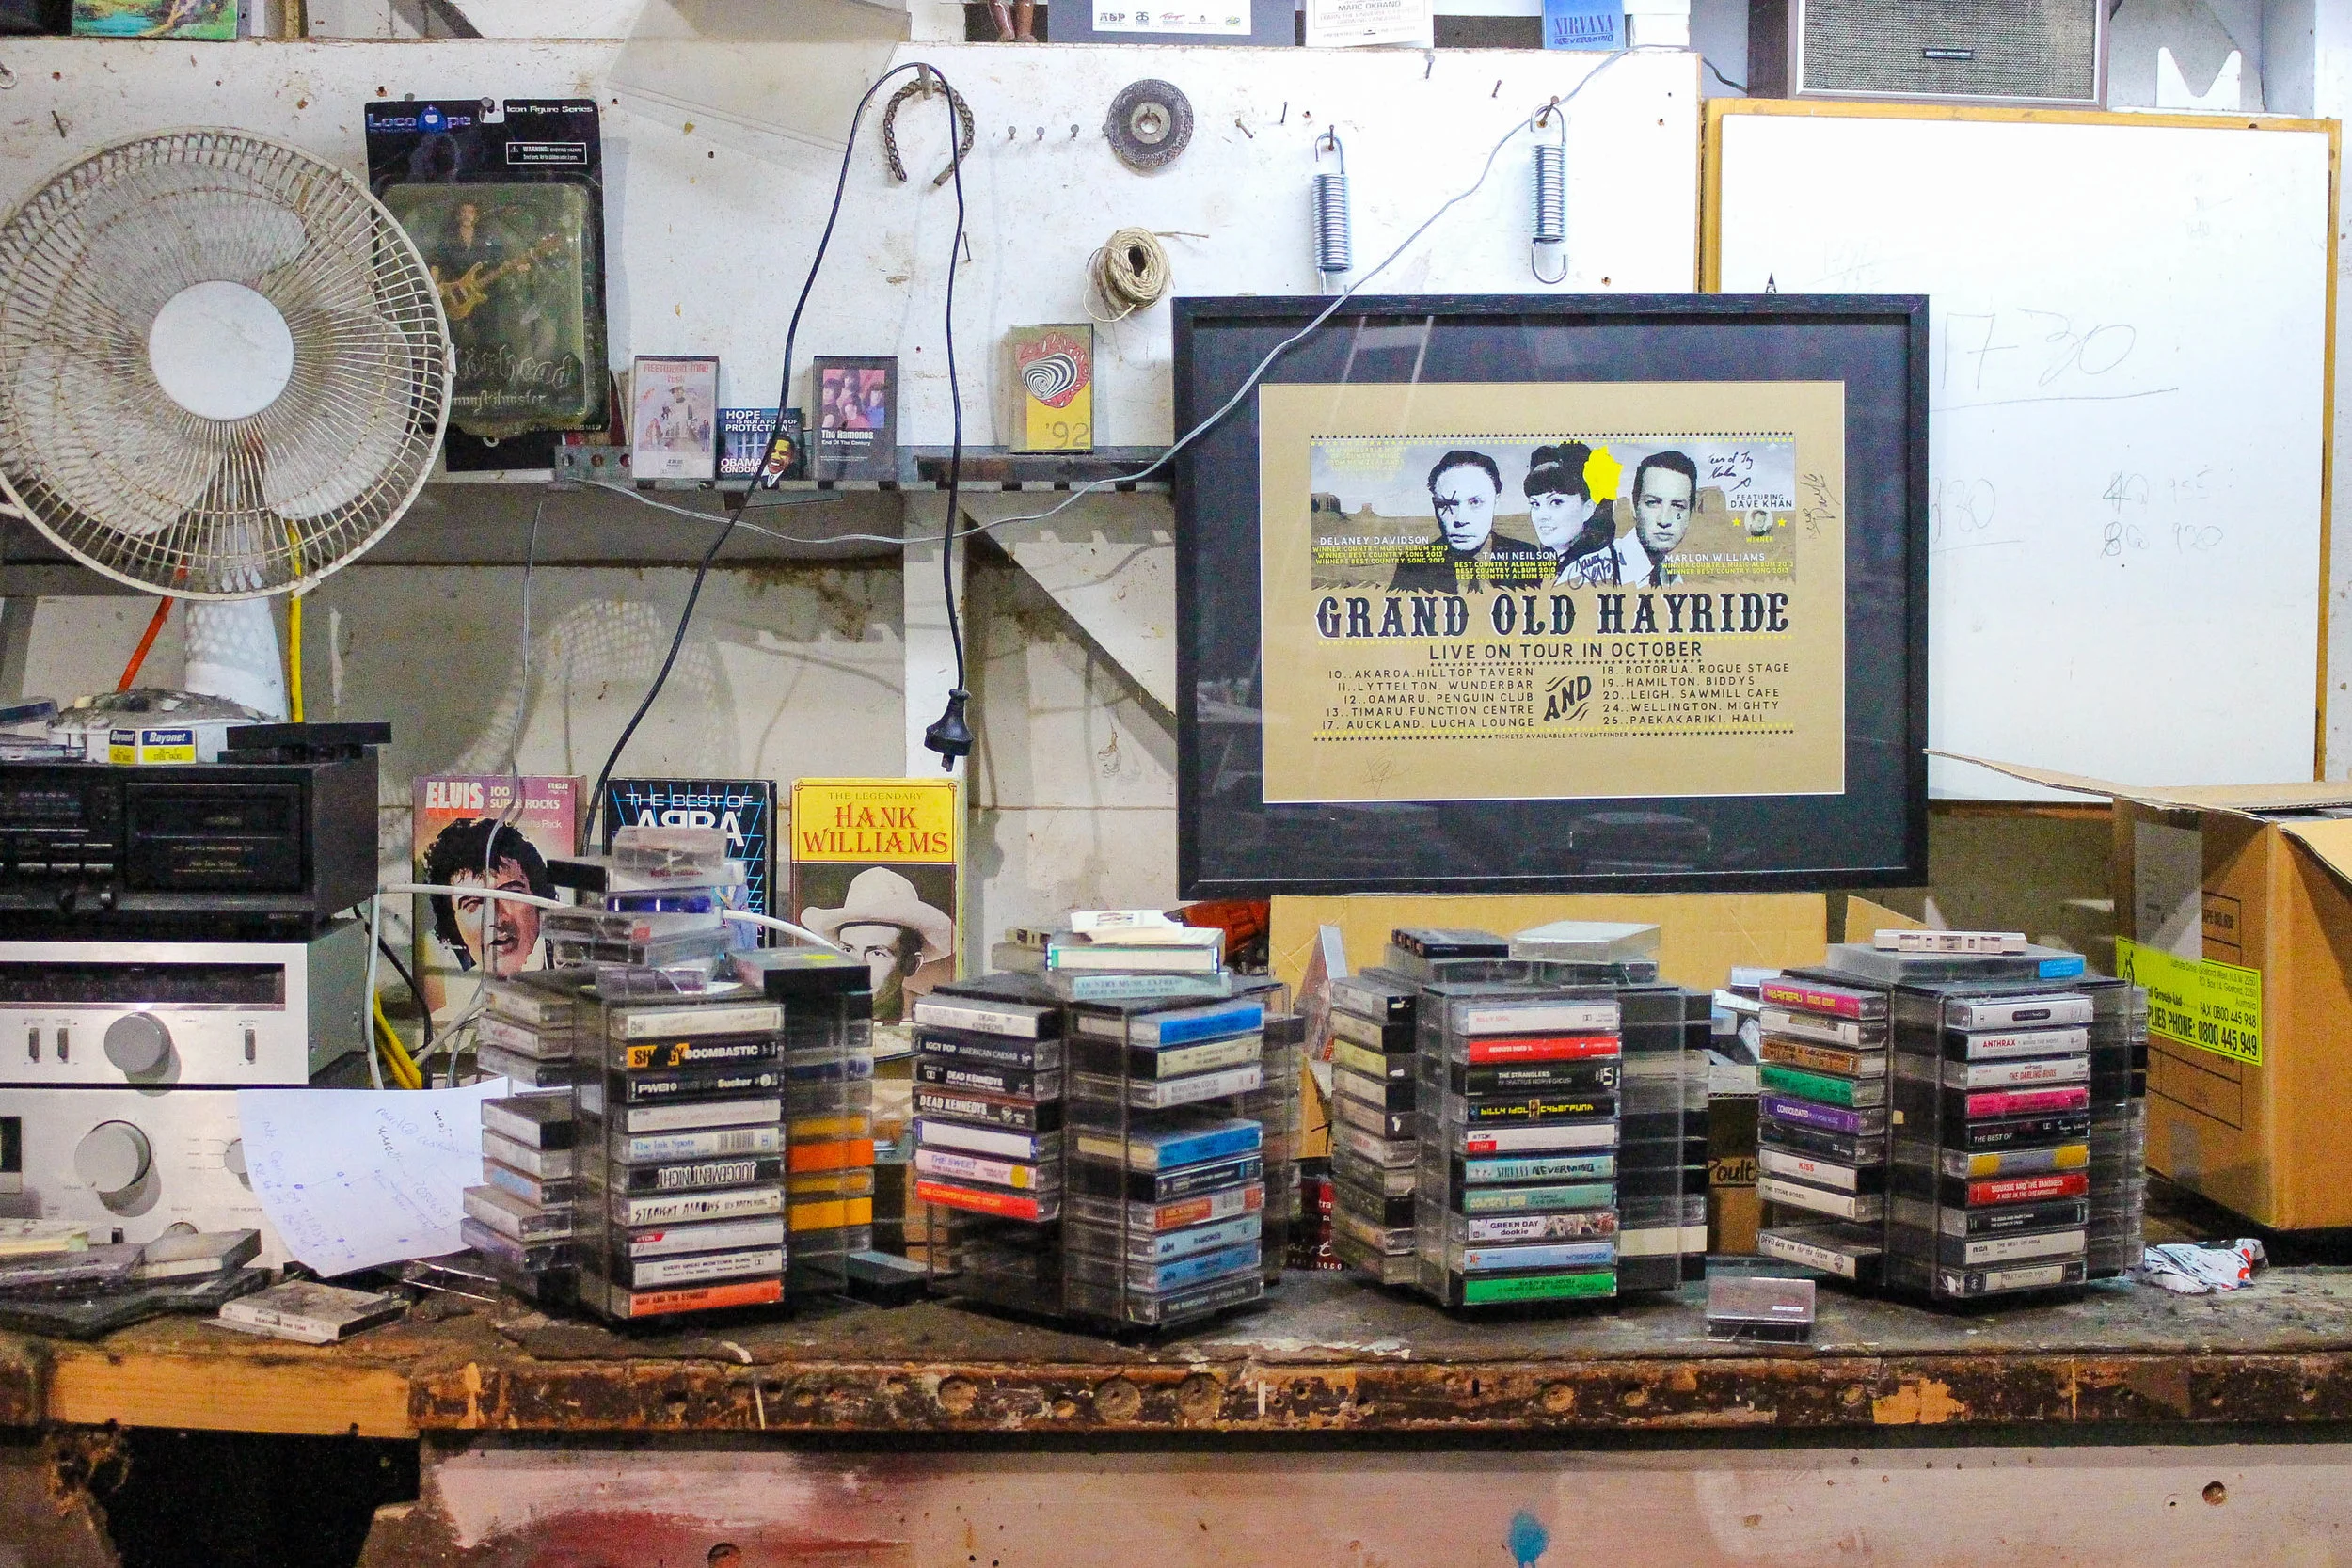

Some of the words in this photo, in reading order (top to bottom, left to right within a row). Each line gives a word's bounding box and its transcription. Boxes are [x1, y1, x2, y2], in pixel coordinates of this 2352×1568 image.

[1554, 14, 1613, 35] NIRVANA
[1554, 34, 1613, 44] NEVERMIND
[726, 410, 761, 419] HOPE
[821, 430, 835, 439] The
[837, 429, 874, 439] Ramones
[721, 458, 762, 467] OBAMA
[1762, 499, 1792, 508] KHAN
[1320, 536, 1369, 545] DELANEY
[1483, 551, 1508, 561] TAMI
[1512, 551, 1556, 560] NEILSON
[1664, 554, 1709, 562] MARLON
[1713, 553, 1765, 562] WILLIAMS
[1315, 596, 1469, 639] GRAND
[1490, 594, 1576, 636] OLD
[1597, 592, 1788, 634] HAYRIDE
[1429, 644, 1476, 659] LIVE
[1485, 644, 1511, 658] ON
[1520, 643, 1573, 658] TOUR
[1582, 643, 1602, 657] IN
[1612, 641, 1703, 657] OCTOBER
[1479, 668, 1534, 677] TAVERN
[1699, 663, 1741, 673] ROGUE
[1748, 662, 1789, 673] STAGE
[1449, 680, 1533, 689] WUNDERBAR
[1706, 676, 1755, 686] BIDDYS
[1436, 693, 1495, 704] PENGUIN
[1500, 692, 1534, 702] CLUB
[1543, 676, 1592, 721] AND
[1680, 689, 1741, 699] SAWMILL
[1747, 688, 1780, 698] CAFE
[1483, 705, 1534, 715] CENTRE
[1727, 701, 1779, 711] MIGHTY
[1430, 719, 1476, 728] LUCHA
[1482, 718, 1534, 727] LOUNGE
[1732, 713, 1766, 723] HALL
[111, 731, 134, 743] Bayonet
[150, 732, 186, 745] Bayonet
[425, 782, 484, 809] ELVIS
[490, 786, 510, 796] 100
[525, 800, 560, 809] ROCKS
[626, 794, 664, 806] THE
[672, 794, 723, 807] BEST
[726, 795, 753, 807] OF
[835, 803, 917, 829] HANK
[542, 820, 562, 829] Pack
[803, 828, 949, 854] WILLIAMS
[2200, 1001, 2211, 1017] FAX
[2213, 1006, 2229, 1021] 0800
[2231, 1010, 2242, 1025] 445
[2244, 1013, 2256, 1028] 948
[2169, 1011, 2196, 1039] PHONE:
[2198, 1021, 2218, 1046] 0800
[2221, 1027, 2237, 1052] 445
[2240, 1031, 2257, 1056] 949
[926, 1041, 941, 1052] IGGY
[1983, 1039, 2015, 1048] ANTHRAX
[685, 1045, 758, 1059] BOOMBASTIC
[947, 1071, 965, 1081] DEAD
[966, 1074, 1003, 1086] KENNEDYS
[920, 1095, 944, 1109] DEAD
[945, 1098, 987, 1115] KENNEDYS
[1777, 1104, 1809, 1118] CONSOLIDATED
[1532, 1164, 1595, 1175] NEVERMIND
[1799, 1162, 1815, 1172] KISS
[656, 1166, 691, 1189] NIGHT
[693, 1162, 757, 1184] JUDGEMENT
[1764, 1184, 1773, 1193] THE
[1774, 1187, 1788, 1196] STONE
[1789, 1190, 1804, 1199] ROSES
[635, 1205, 678, 1222] STRAIGHT
[683, 1201, 720, 1212] ARROWS
